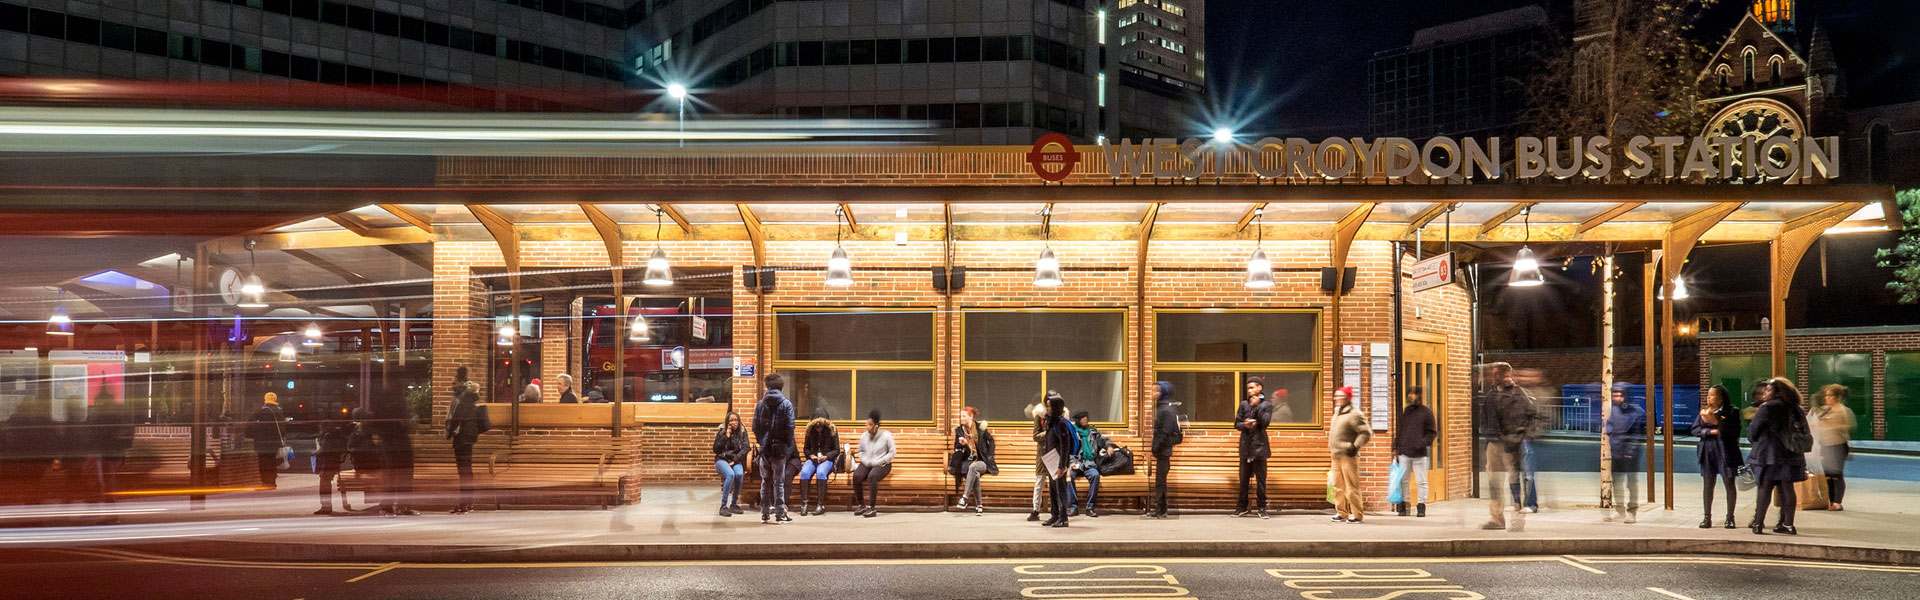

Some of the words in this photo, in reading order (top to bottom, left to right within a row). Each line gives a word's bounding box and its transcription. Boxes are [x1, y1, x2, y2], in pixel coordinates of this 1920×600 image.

[1102, 137, 1234, 180] WEST
[1251, 136, 1500, 180] CROYDON
[1515, 136, 1612, 180] BUS
[1623, 136, 1840, 180] STATION
[602, 361, 616, 371] Go
[1013, 564, 1199, 600] STO
[1264, 568, 1485, 600] BUS
